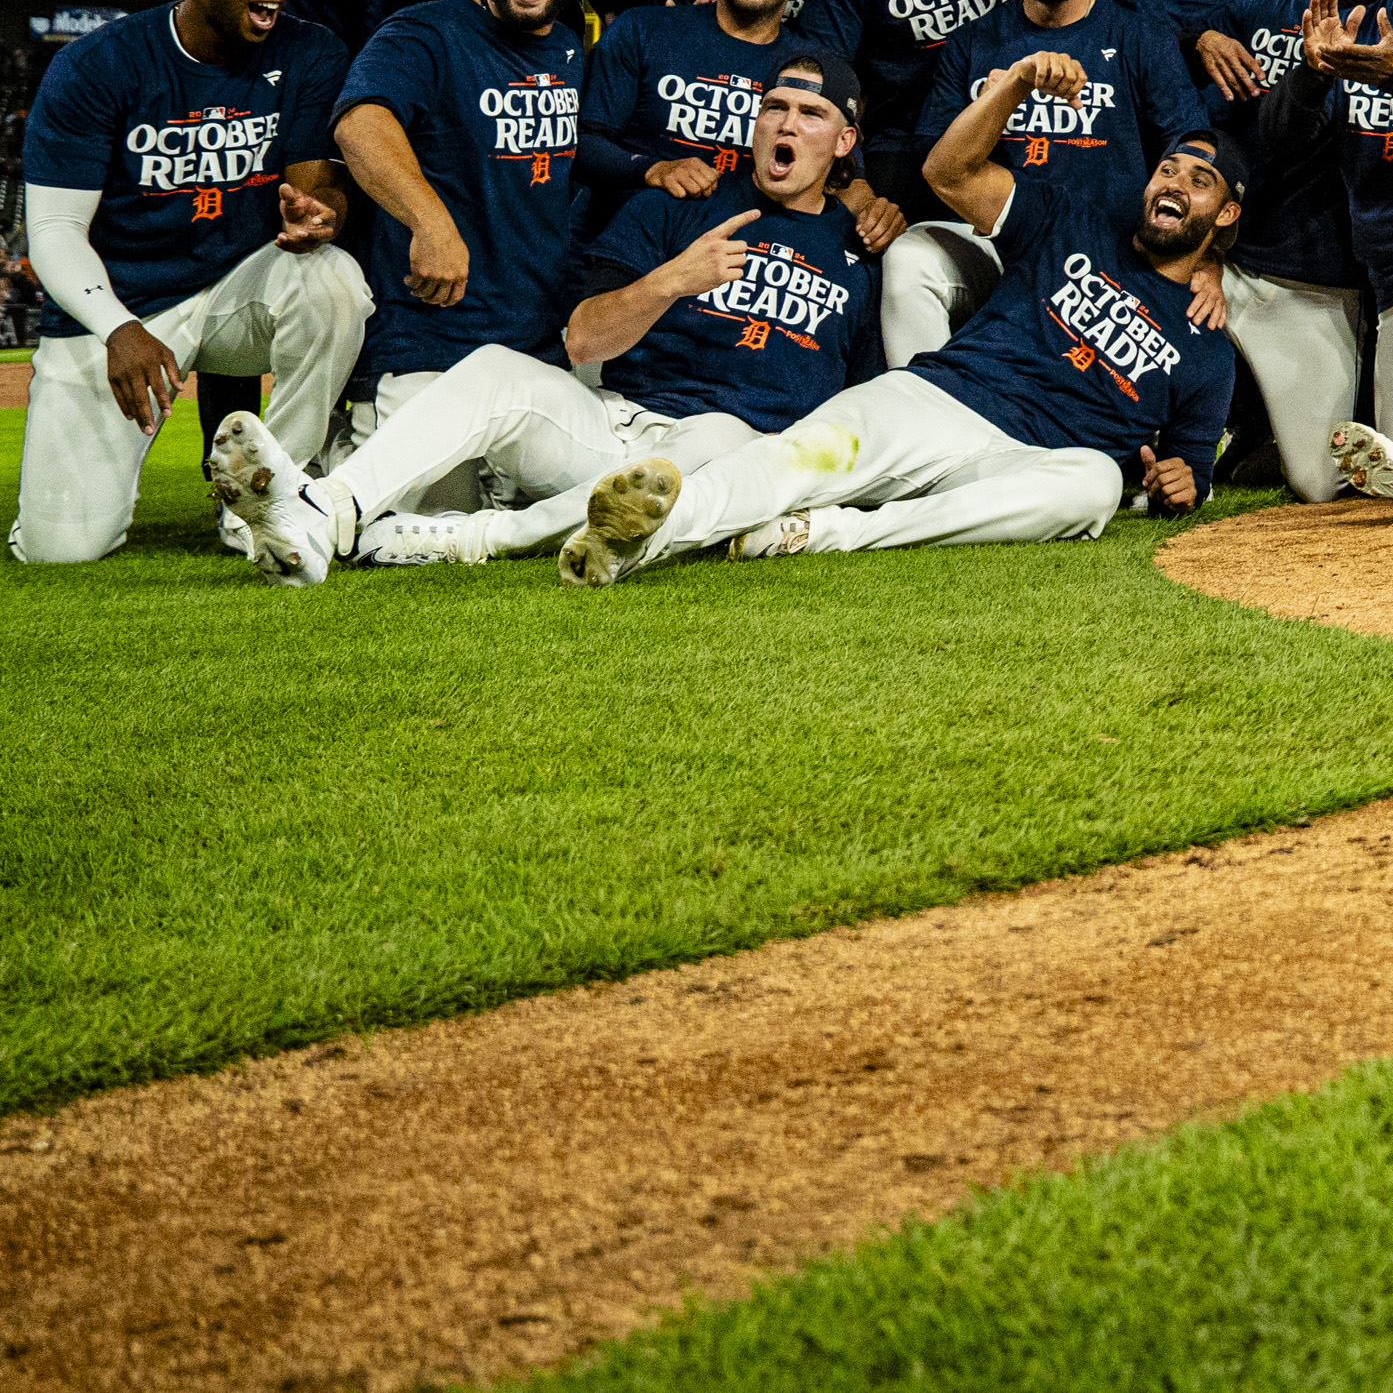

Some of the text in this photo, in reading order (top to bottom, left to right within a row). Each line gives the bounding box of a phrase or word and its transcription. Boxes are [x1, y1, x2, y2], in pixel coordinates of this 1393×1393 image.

[658, 74, 763, 110] OCTO
[127, 112, 280, 155] OCTOBER
[666, 103, 755, 148] REA
[1003, 104, 1102, 135] EADY
[139, 140, 272, 191] READY
[743, 253, 850, 315] TOBER
[1050, 280, 1158, 382] READY
[1063, 252, 1181, 375] OCTOBER
